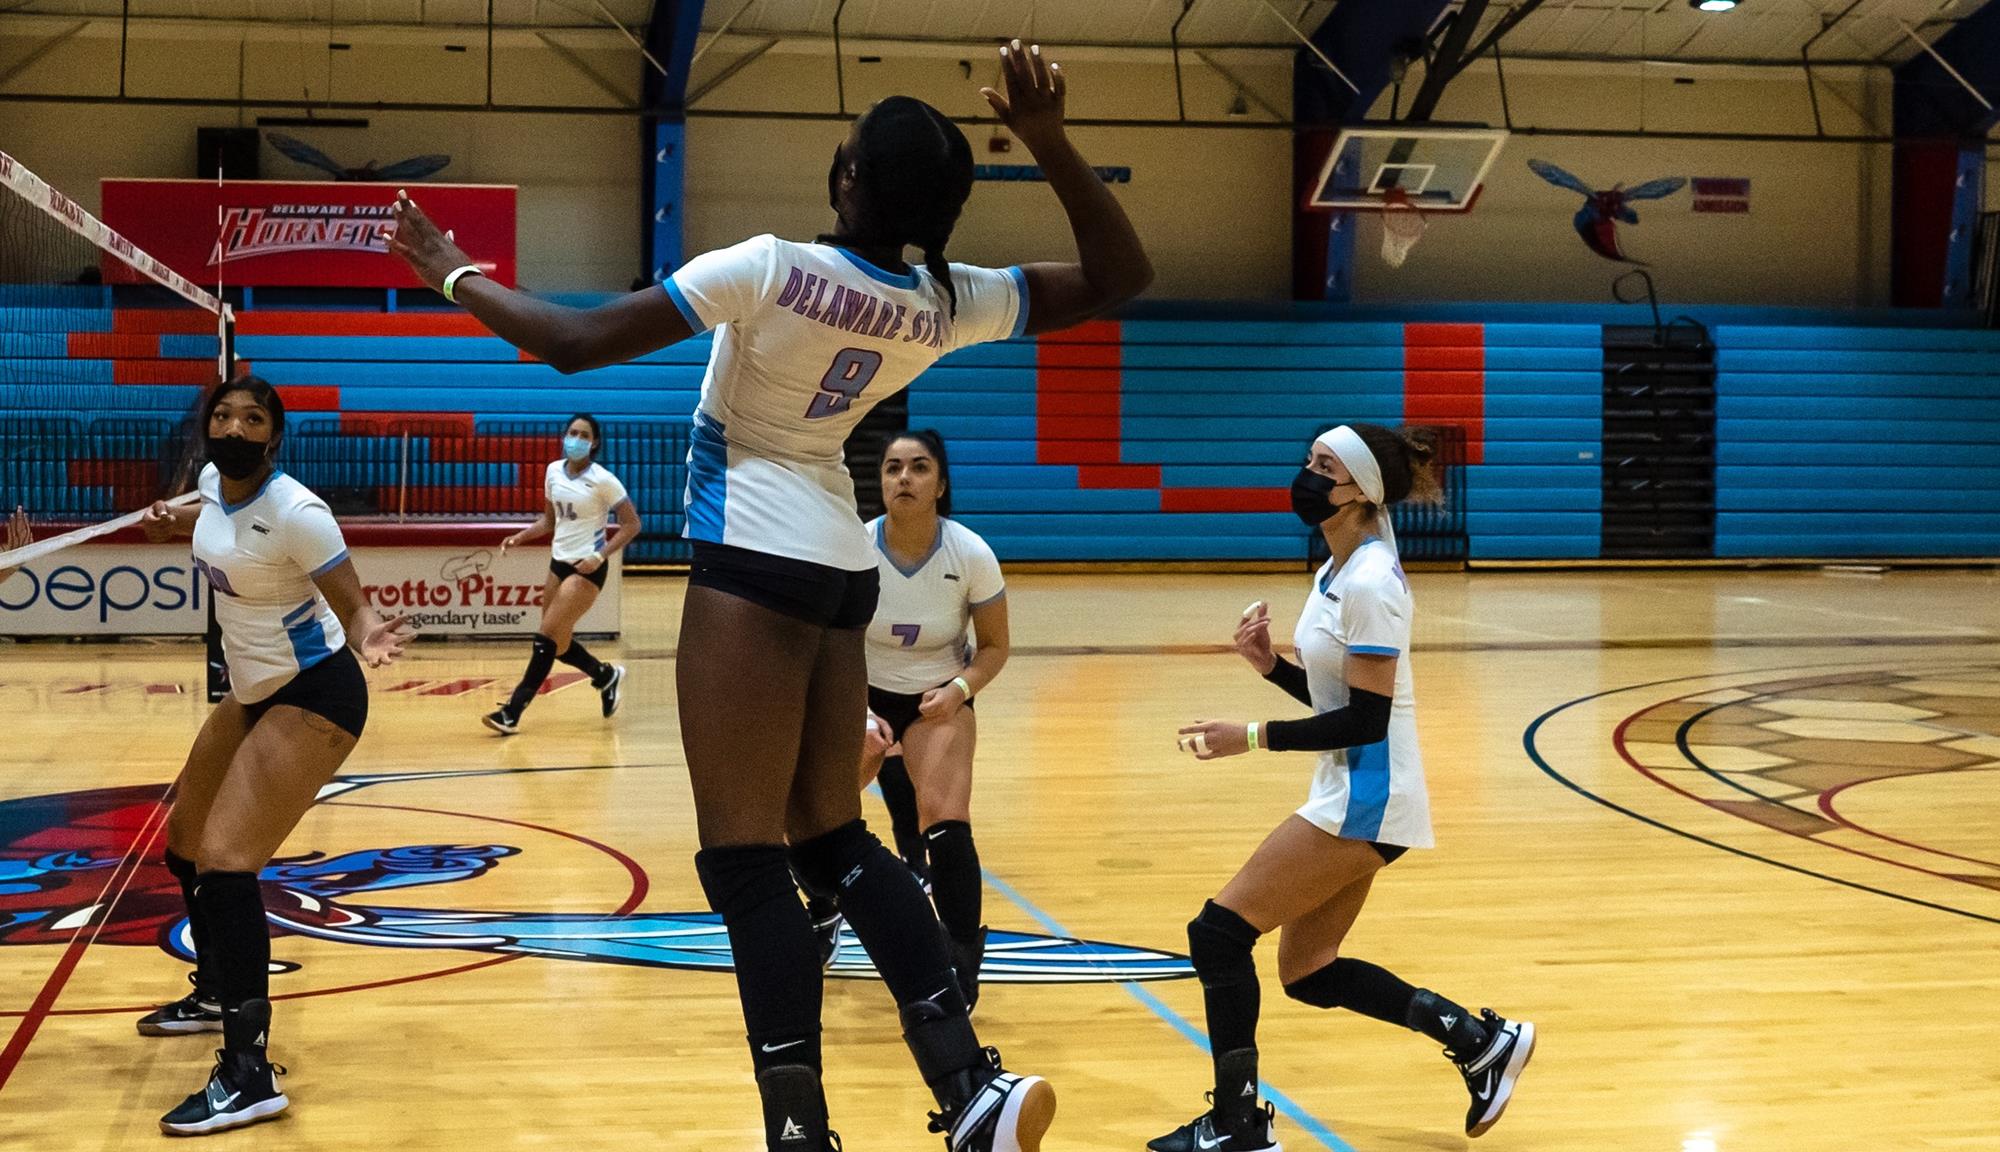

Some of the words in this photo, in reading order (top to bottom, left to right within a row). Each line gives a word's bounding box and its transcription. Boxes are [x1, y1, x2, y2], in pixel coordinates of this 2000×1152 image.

[271, 205, 345, 215] DELAWARE
[776, 266, 906, 340] DELAWARE
[803, 347, 883, 418] 9
[362, 577, 452, 607] rotto
[399, 610, 480, 629] egendary
[892, 624, 921, 647] 7
